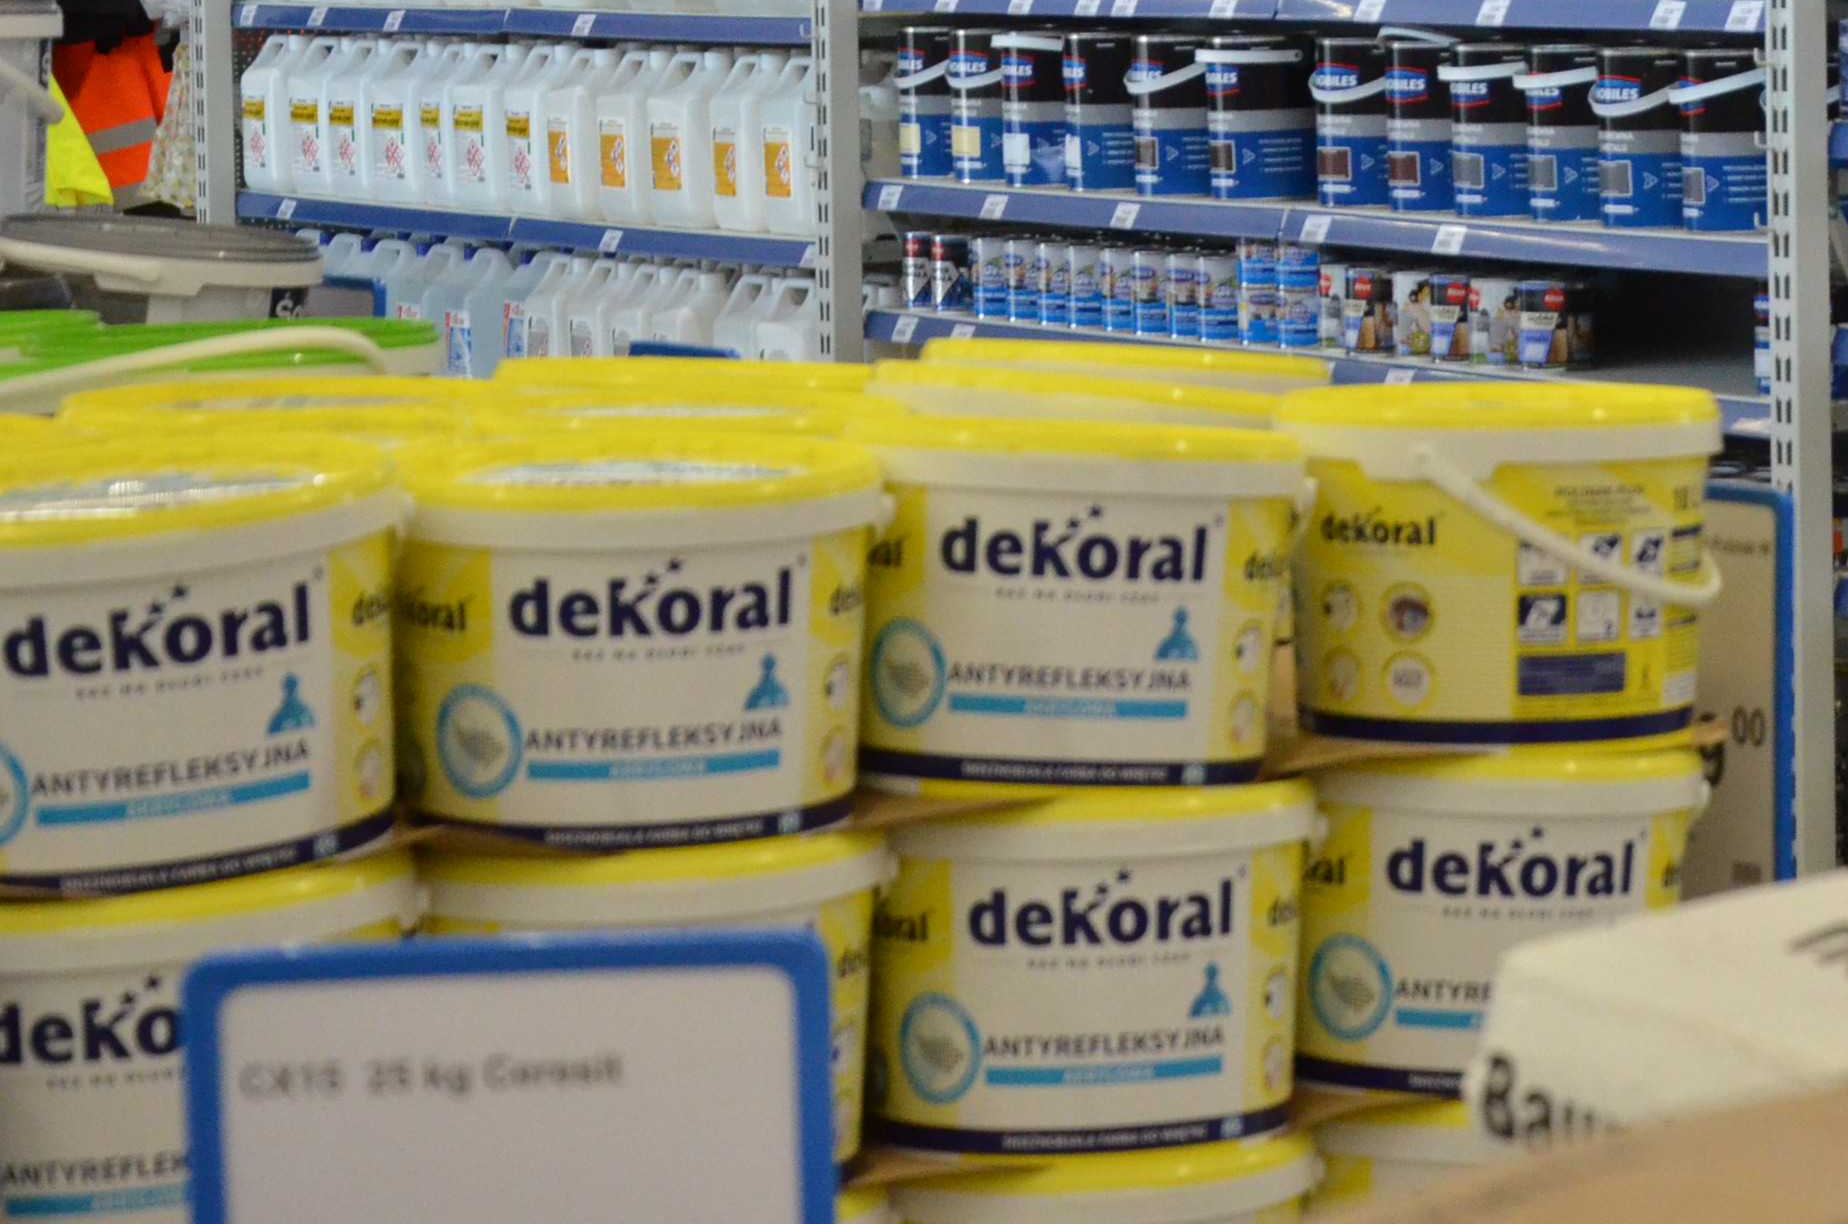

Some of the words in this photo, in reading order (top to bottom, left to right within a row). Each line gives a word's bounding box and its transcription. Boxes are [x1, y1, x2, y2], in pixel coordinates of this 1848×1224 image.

[942, 506, 1208, 583] dekoral
[1322, 508, 1438, 547] dekoral
[3, 582, 310, 678] dekoral
[509, 560, 792, 638] dekoral
[947, 662, 1191, 693] ANTYREFLEKSYJNA
[32, 737, 310, 795] ANTYREFLEKSYJNA
[525, 717, 783, 751] ANTYREFLEKSYJNA
[1386, 827, 1634, 898] dekoral
[968, 868, 1232, 947] dekoral
[983, 1025, 1224, 1058] ANTYREFLEKSYJNA
